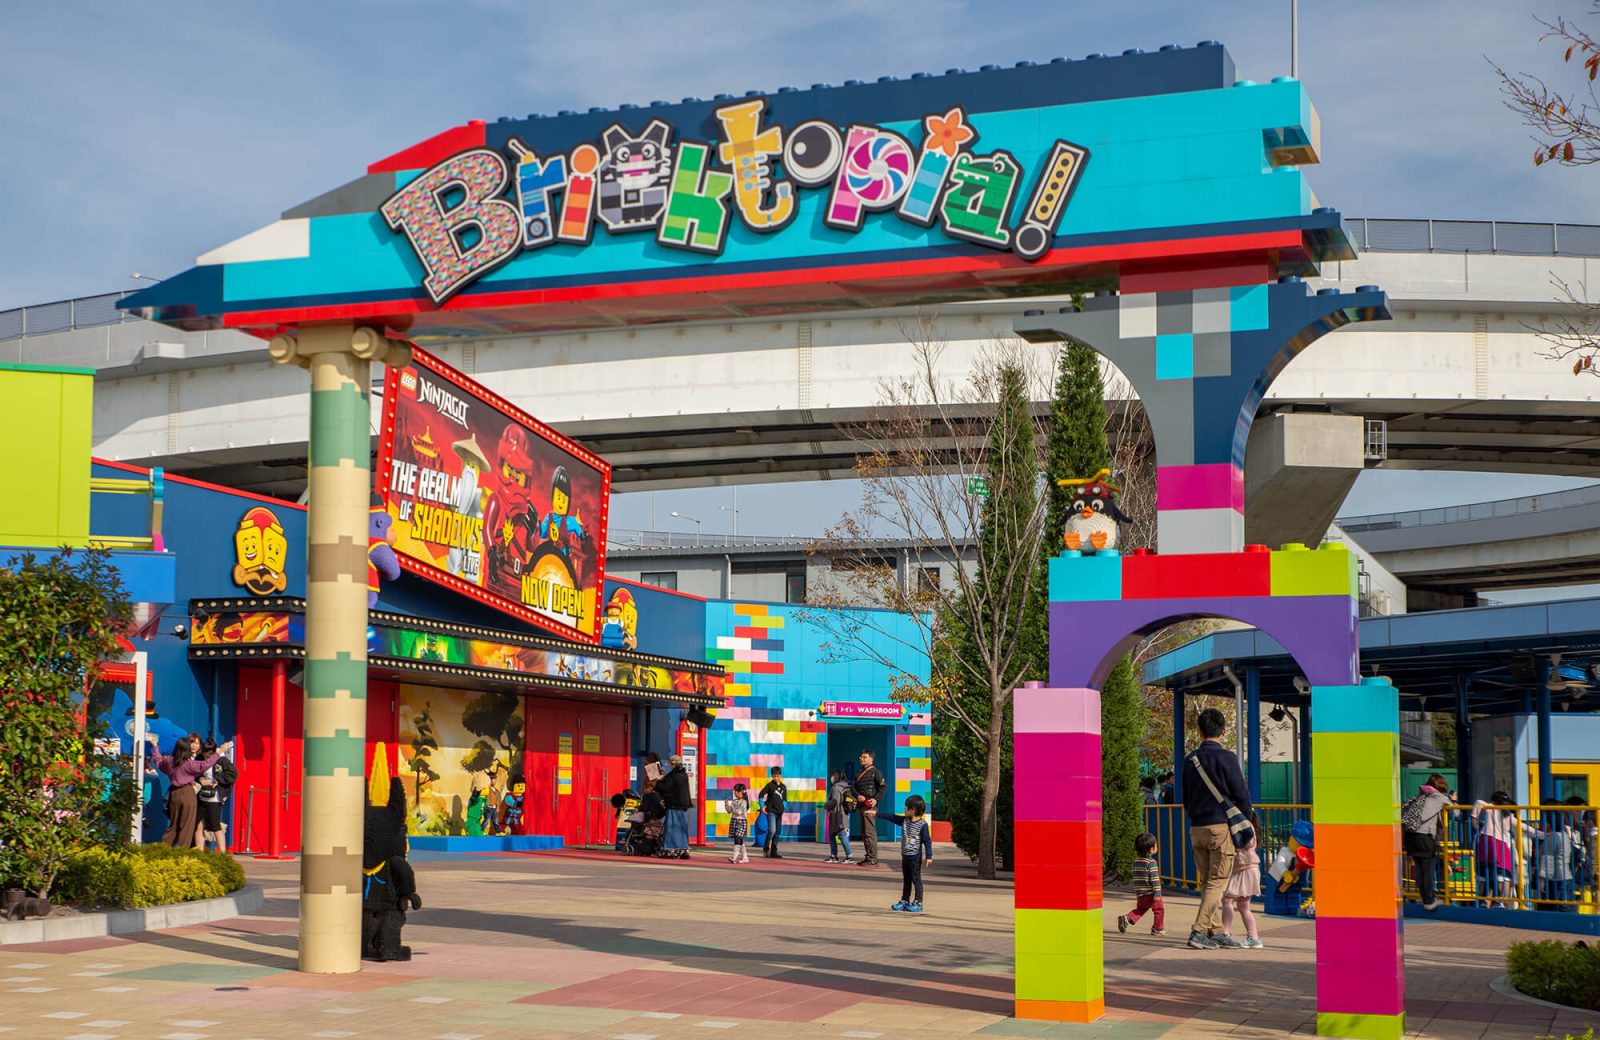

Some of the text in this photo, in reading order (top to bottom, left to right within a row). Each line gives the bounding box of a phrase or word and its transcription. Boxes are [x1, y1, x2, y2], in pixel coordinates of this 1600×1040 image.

[380, 98, 1087, 304] Bricktopia!
[416, 376, 470, 430] NINJAGO
[391, 459, 462, 507] THE REALM
[399, 500, 484, 552] OF SHADOWS
[463, 555, 480, 574] LIVE
[521, 575, 584, 619] NOW OPEN!
[857, 706, 899, 715] WASHROOM
